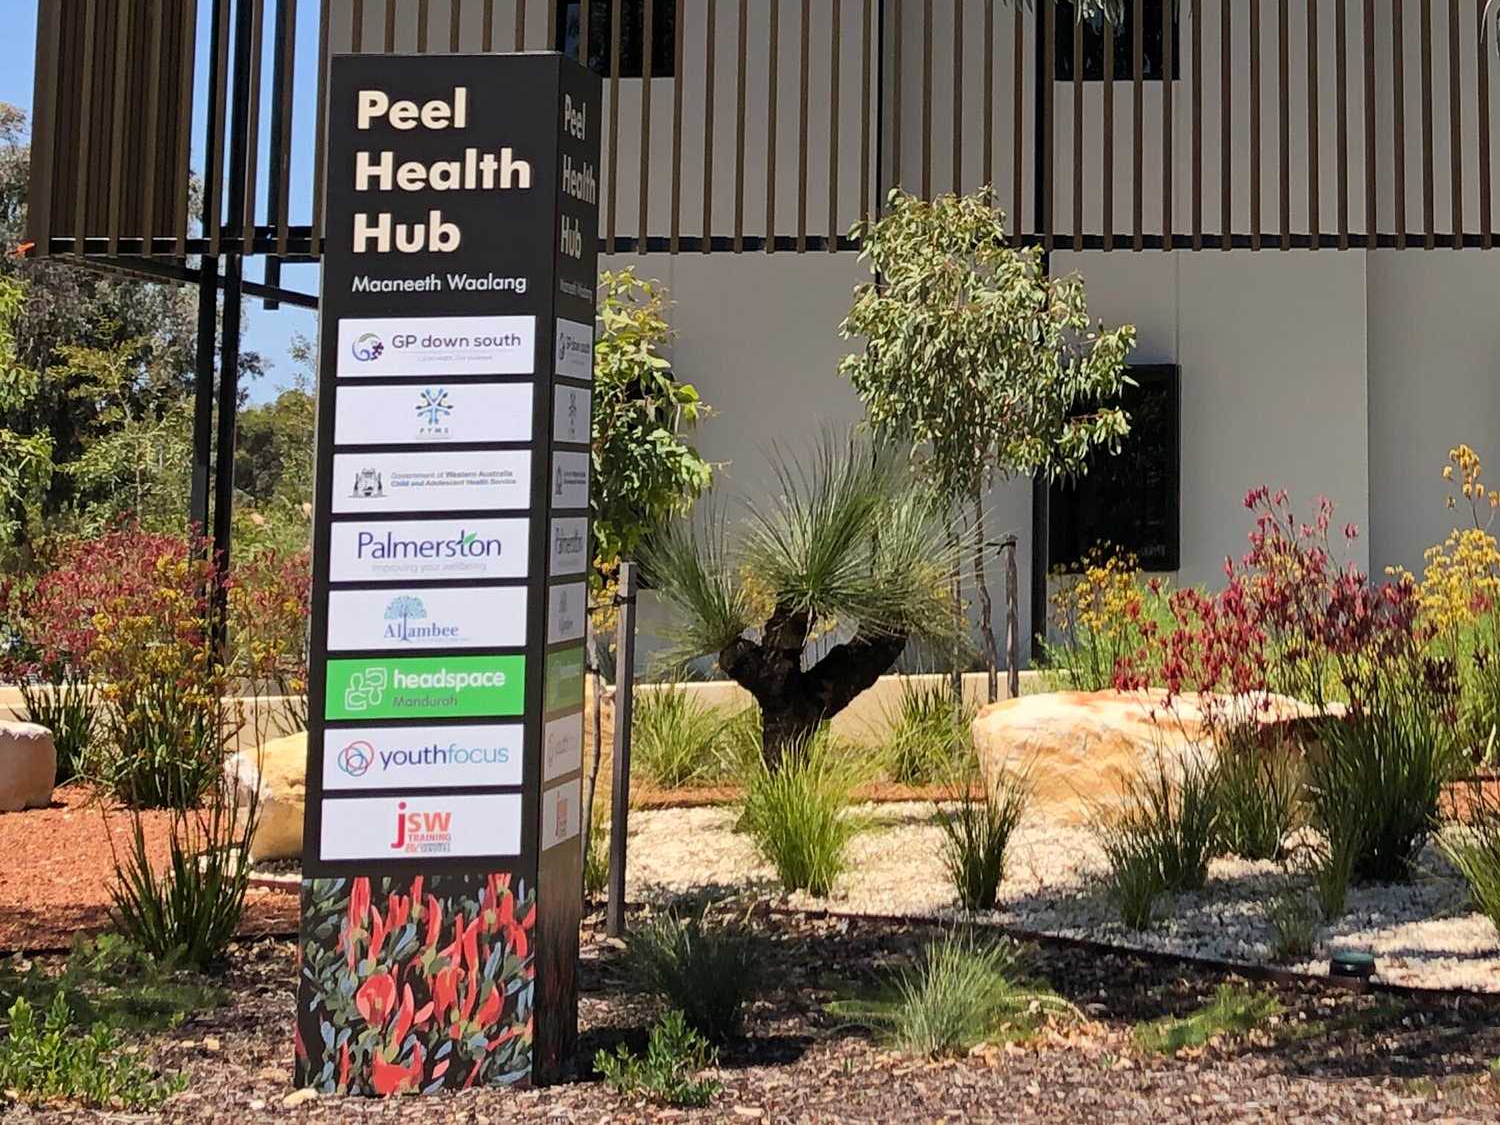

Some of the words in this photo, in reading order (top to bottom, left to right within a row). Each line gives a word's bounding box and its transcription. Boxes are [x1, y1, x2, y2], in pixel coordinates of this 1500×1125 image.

[357, 87, 467, 130] Peel
[564, 93, 586, 140] Peel
[355, 147, 531, 191] Health
[562, 154, 596, 205] Health
[353, 210, 461, 253] Hub
[561, 214, 582, 259] Hub
[352, 274, 441, 292] Maaneeth
[446, 273, 527, 294] Waalang
[392, 334, 417, 348] GP
[421, 334, 470, 348] down
[473, 333, 521, 347] south
[358, 530, 501, 559] Palmerston
[393, 695, 458, 707] Mandurah
[394, 667, 506, 692] headspace
[390, 801, 452, 849] jsw
